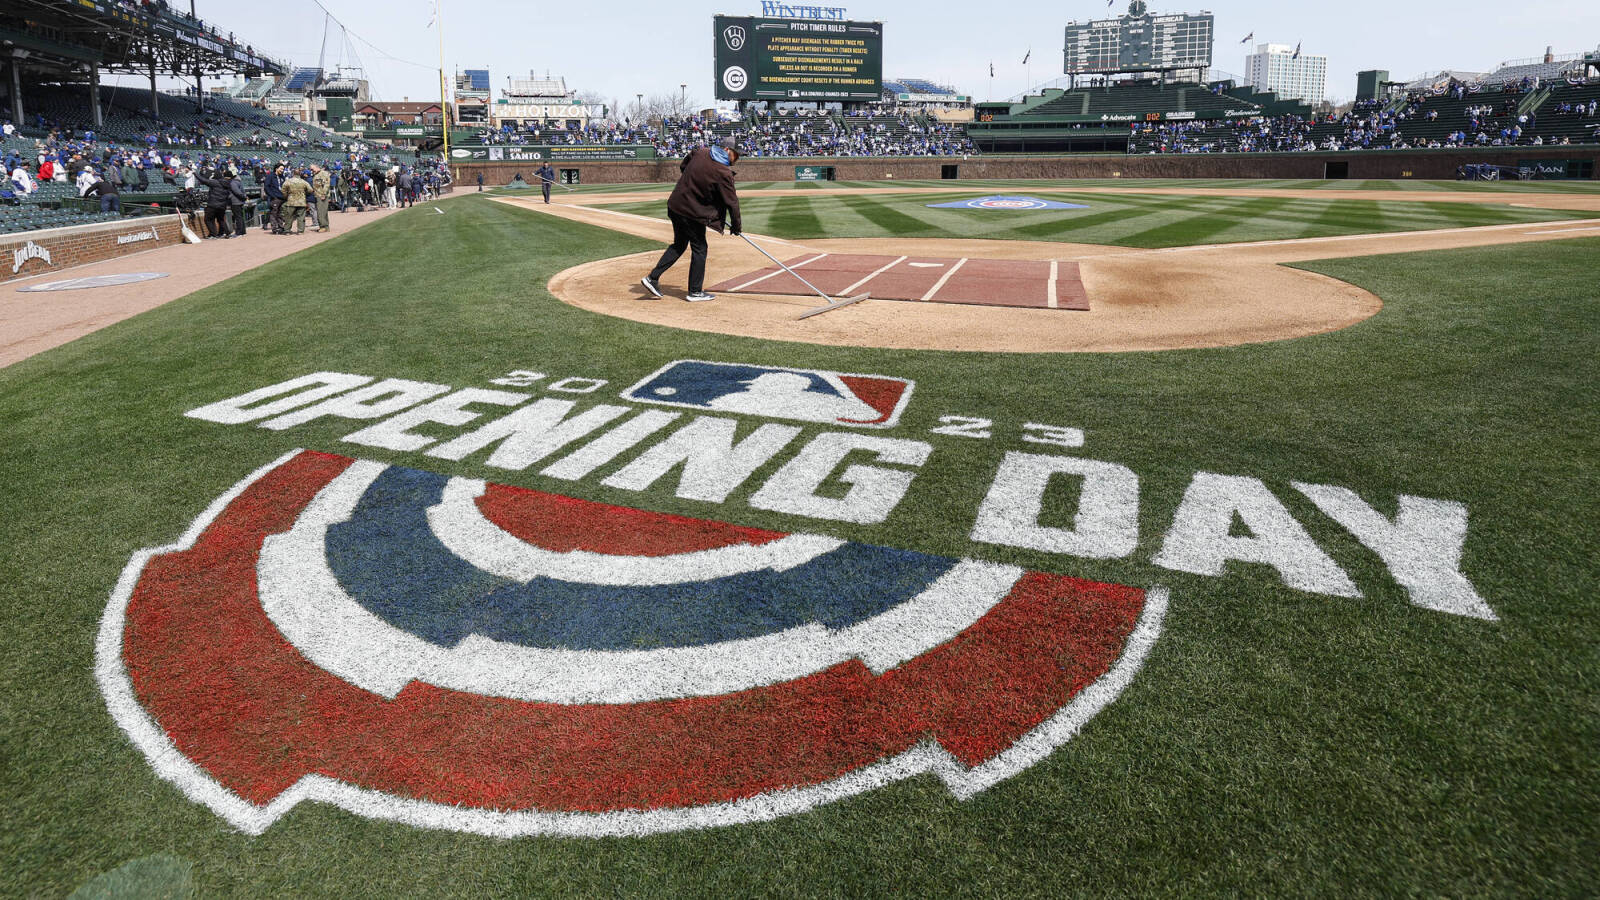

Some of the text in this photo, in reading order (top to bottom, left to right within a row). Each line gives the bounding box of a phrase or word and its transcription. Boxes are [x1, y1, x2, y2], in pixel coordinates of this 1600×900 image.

[761, 0, 846, 20] WINTRUST
[790, 23, 846, 33] PITCH TIMER RULES
[515, 105, 592, 118] HORIZON
[1225, 109, 1261, 117] Budweiser
[28, 241, 51, 265] BEAM
[489, 370, 609, 394] 20
[931, 414, 1084, 447] 23
[184, 371, 932, 525] OPENING
[970, 450, 1499, 621] DAY
